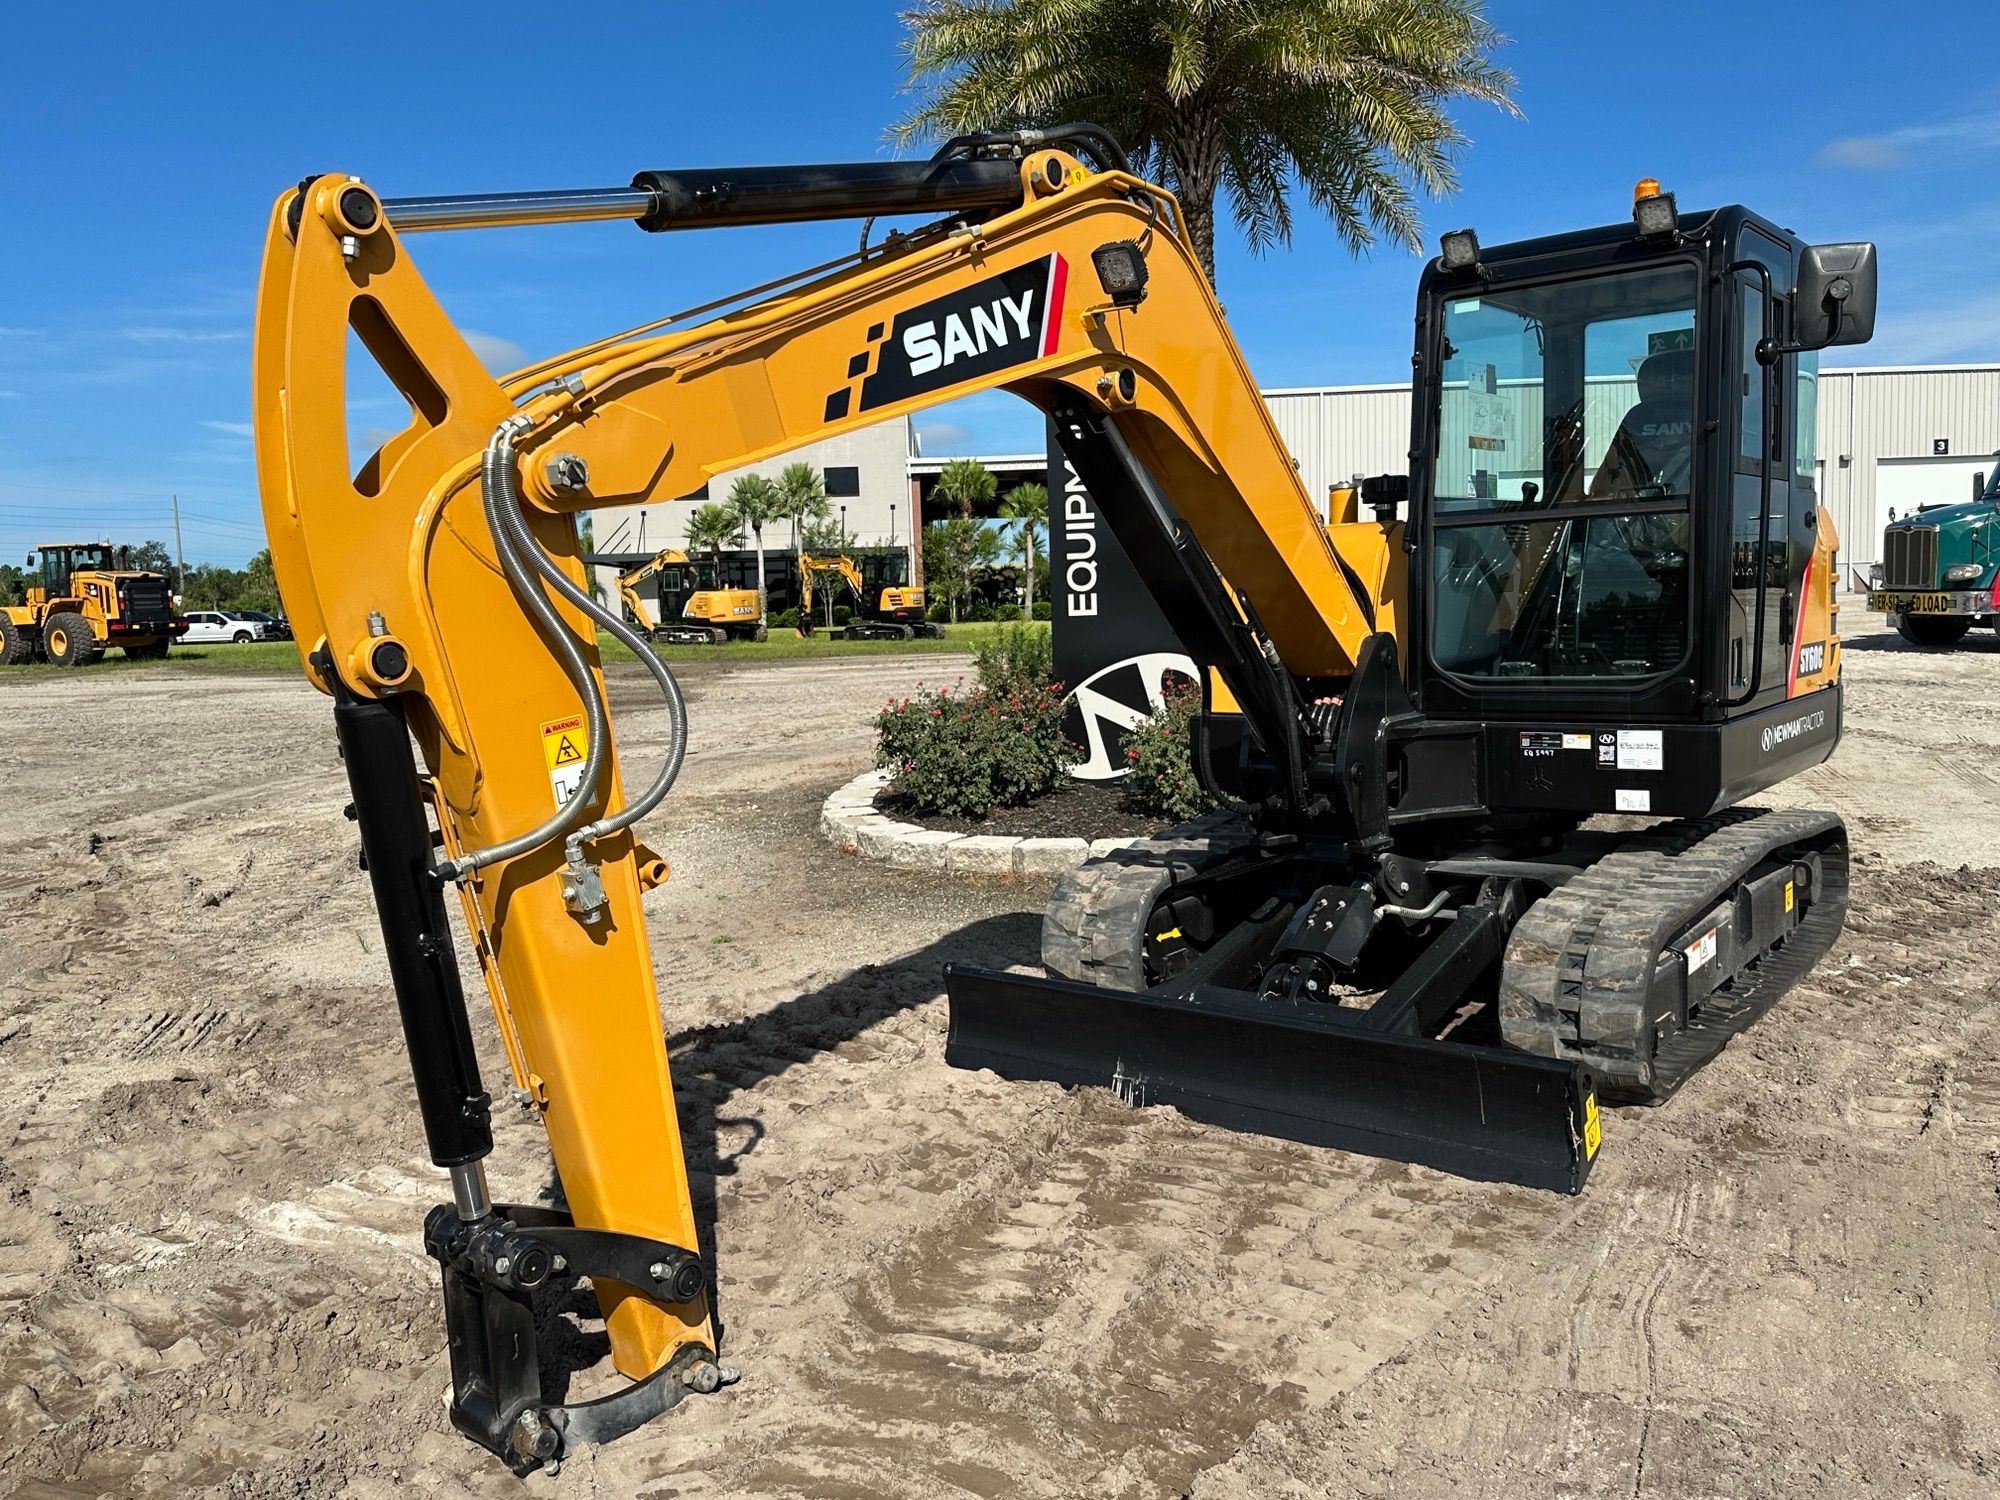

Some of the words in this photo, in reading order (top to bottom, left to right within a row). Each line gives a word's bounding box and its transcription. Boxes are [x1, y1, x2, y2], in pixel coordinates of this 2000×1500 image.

[903, 289, 1033, 377] SANY
[1937, 441, 1945, 451] 3
[1064, 453, 1098, 617] EQUIPM
[1923, 595, 1948, 612] LOAD
[1800, 645, 1823, 673] SY60C
[552, 719, 579, 731] WARNING
